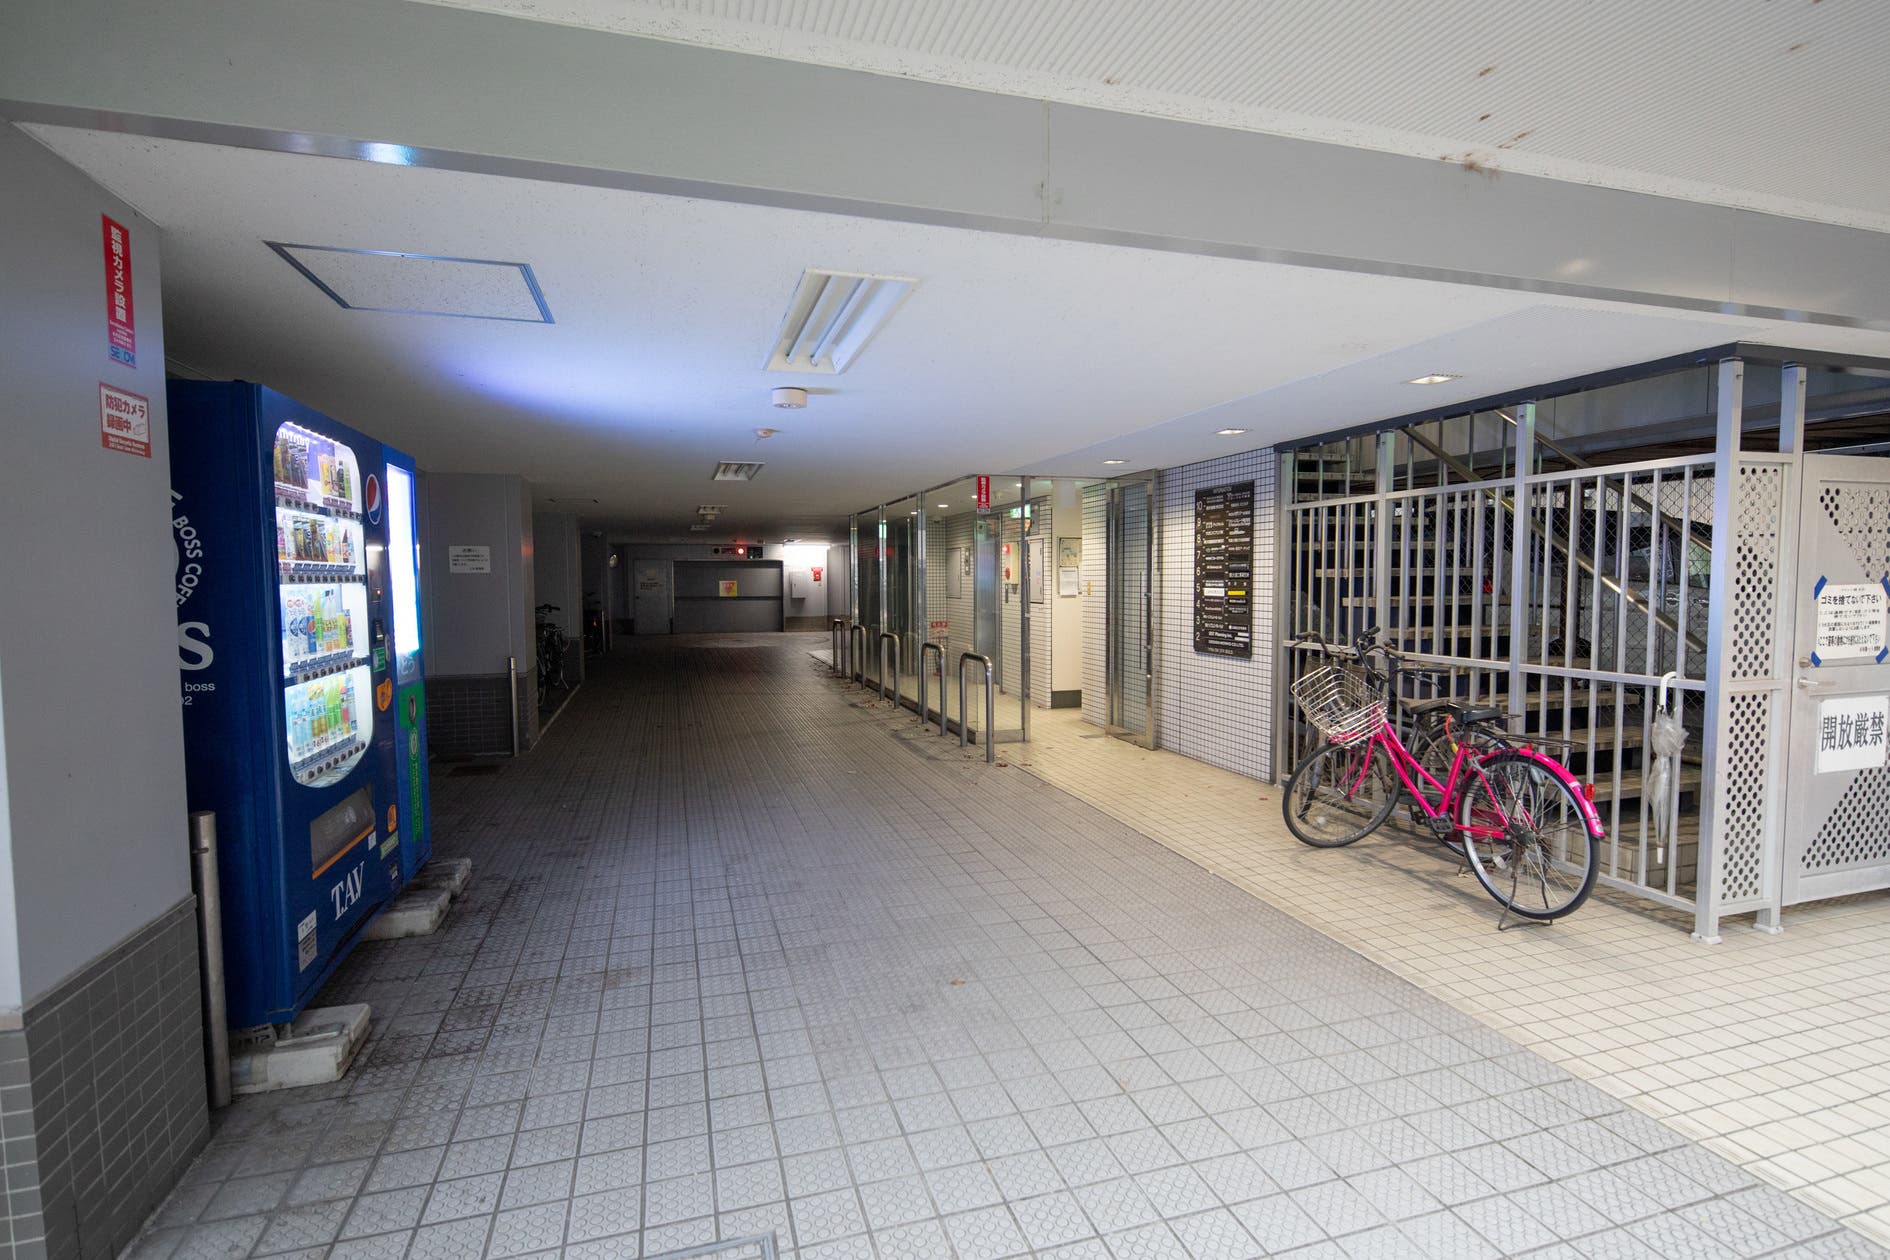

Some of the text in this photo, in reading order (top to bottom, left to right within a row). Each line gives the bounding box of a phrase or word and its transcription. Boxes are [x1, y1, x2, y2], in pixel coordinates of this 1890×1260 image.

[105, 393, 146, 418] 防犯カメラ
[173, 515, 203, 558] BOSS
[176, 563, 202, 607] COFF
[1821, 594, 1882, 605] ゴミを捨てないで下さい
[178, 621, 214, 671] S
[184, 681, 216, 692] boss
[1821, 711, 1884, 752] 開放厳禁
